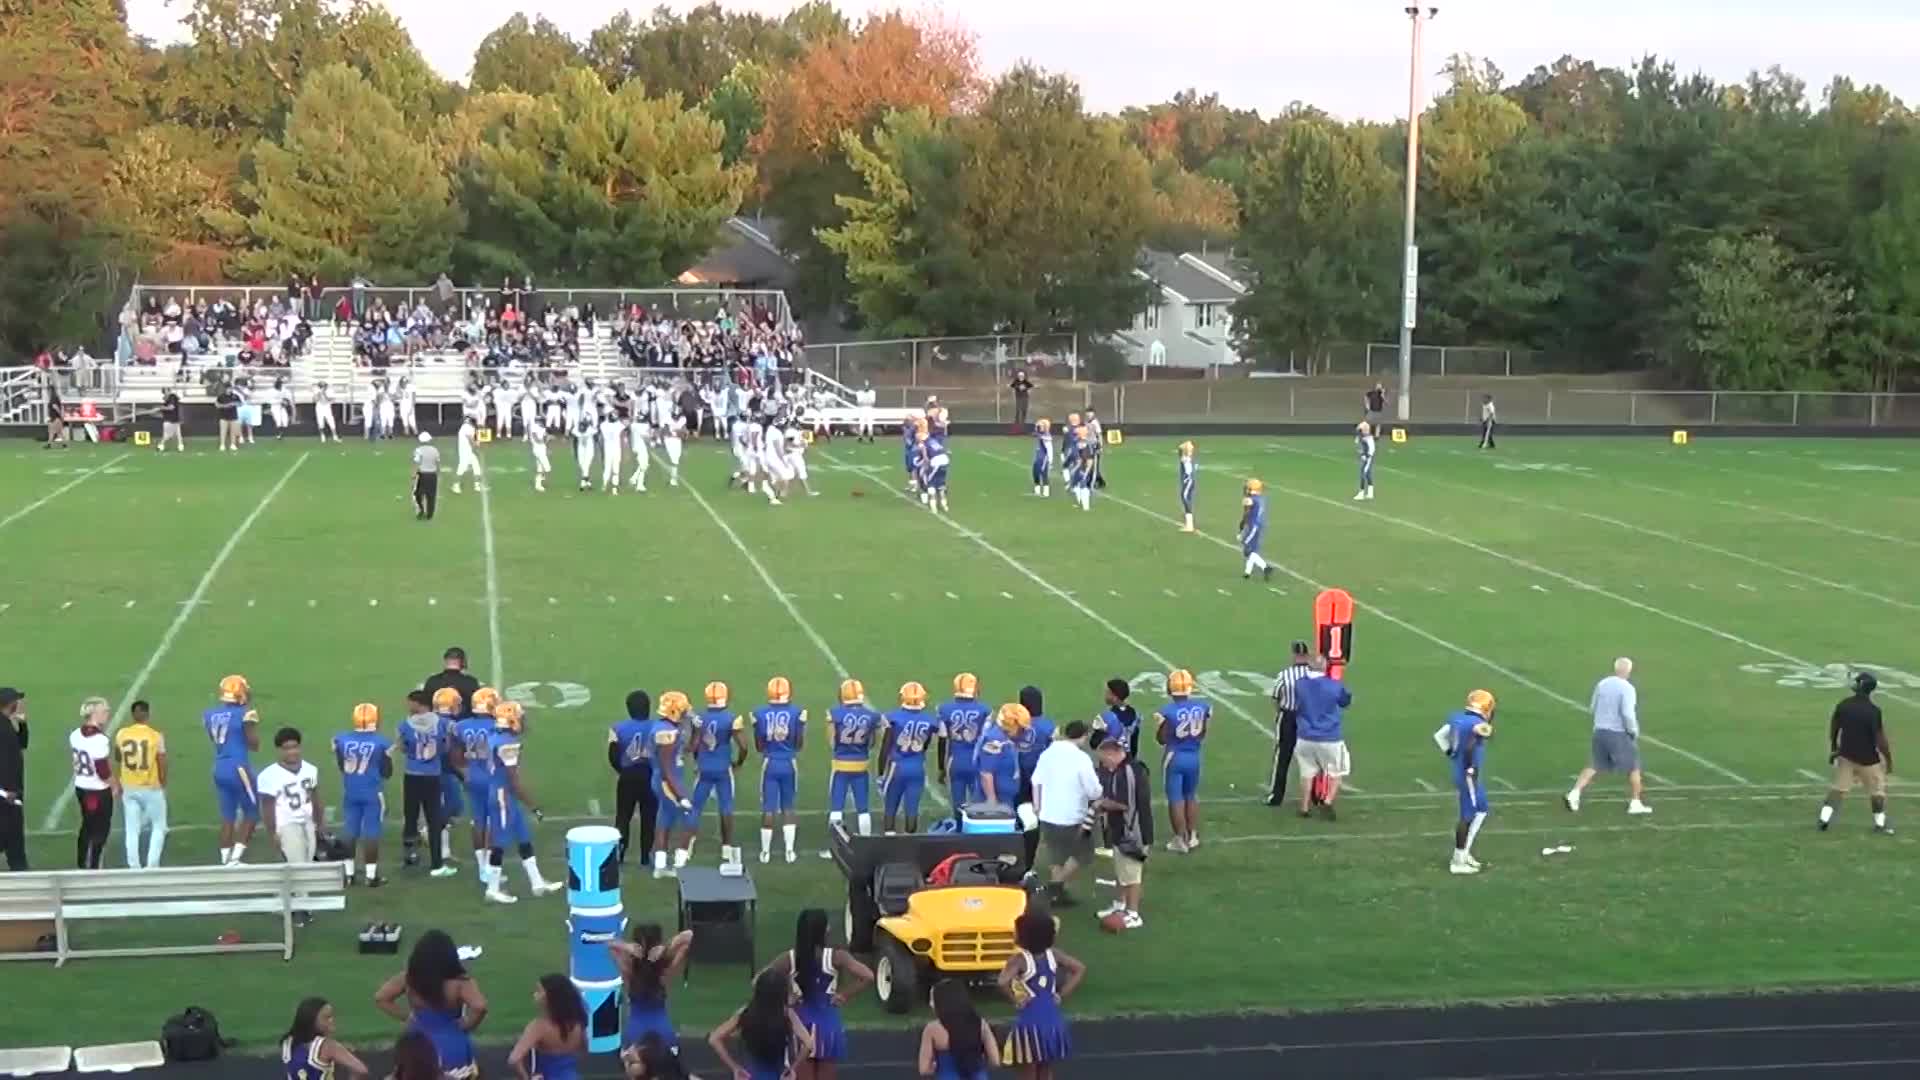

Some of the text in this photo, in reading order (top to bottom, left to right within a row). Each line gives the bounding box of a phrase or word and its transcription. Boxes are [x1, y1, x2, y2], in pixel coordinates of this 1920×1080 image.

[1329, 626, 1342, 659] 1
[840, 713, 869, 745] 22
[896, 720, 930, 753] 45
[950, 710, 979, 742] 25
[1176, 707, 1204, 738] 20
[122, 739, 149, 771] 21
[344, 740, 374, 775] 57
